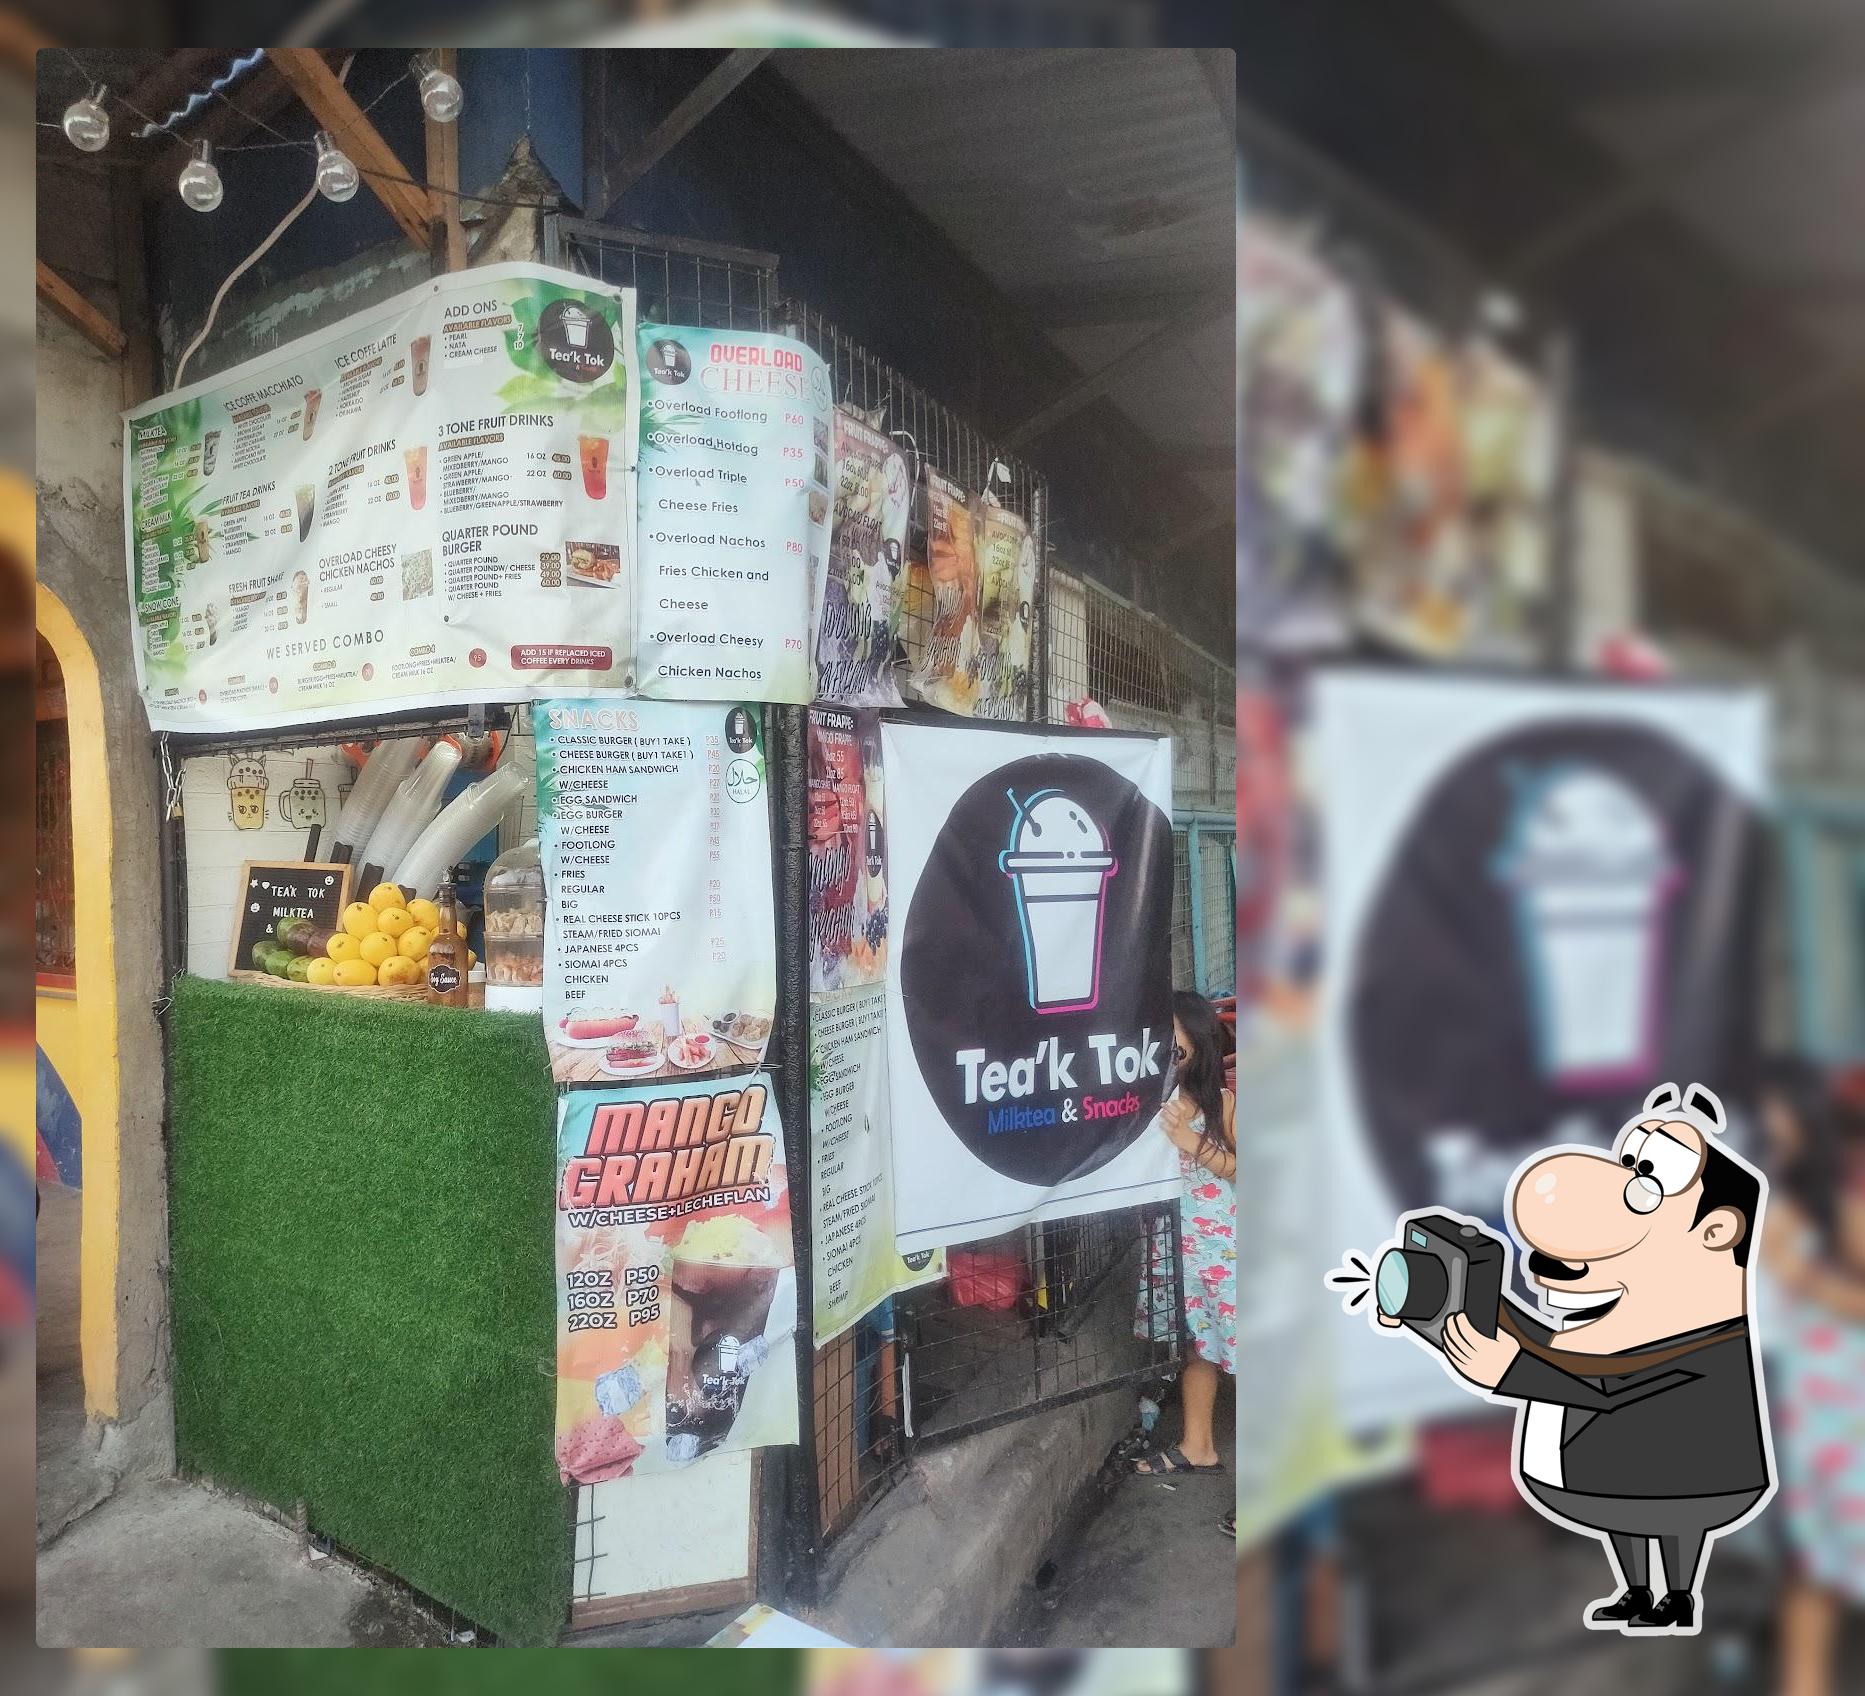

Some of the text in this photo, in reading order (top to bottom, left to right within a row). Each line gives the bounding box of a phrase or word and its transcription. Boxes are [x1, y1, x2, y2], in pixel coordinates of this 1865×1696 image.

[445, 300, 497, 319] ADD ONS
[335, 334, 396, 369] ICE COFFE LATTE
[450, 341, 523, 358] CREAM CHEESE 10
[550, 348, 605, 367] Tea'k Tok
[710, 344, 802, 372] OVERLOAD
[236, 393, 258, 408] COFFE
[256, 375, 303, 400] MACCHIATO
[655, 400, 710, 415] Overload
[715, 408, 767, 423] Footlong
[439, 415, 553, 437] 3 TONE FRUIT DRINKS
[367, 440, 396, 457] DRINKS
[655, 433, 802, 458] Overload Hotdog P35
[655, 466, 714, 479] Overload
[718, 470, 747, 484] Triple
[252, 481, 276, 496] DRINKS
[658, 499, 738, 513] Cheese Fries
[442, 524, 538, 542] QUARTER POUND
[443, 541, 481, 556] BURGER
[656, 532, 802, 553] Overload Nachos P80
[320, 544, 396, 568] OVERLOAD CHEESY
[540, 553, 561, 561] 29.00
[320, 557, 394, 581] CHICKEN NACHOS
[659, 566, 769, 581] Fries Chicken and
[229, 577, 266, 593] FRESH FRUIT
[457, 592, 478, 600] CHEESE
[659, 599, 709, 609] Cheese
[267, 630, 383, 659] WE SERVED COMBO
[656, 632, 802, 649] Overload Cheesy P70
[555, 649, 588, 657] REPLACED
[658, 665, 762, 679] Chicken Nachos
[549, 708, 639, 731] SNACKS
[809, 710, 853, 730] FRUIT FRAPPE:
[558, 736, 684, 745] CLASSIC BURGER TAKE
[559, 751, 593, 759] CHEESE
[596, 751, 630, 760] BURGER
[560, 765, 678, 774] CHICKEN HAM SANDWICH
[728, 767, 758, 787] حلال
[559, 780, 609, 790] W/CHEESE
[560, 794, 637, 805] EGG SANDWICH
[561, 810, 622, 819] EGG BURGER
[561, 826, 609, 835] W/CHEESE
[561, 840, 615, 850] FOOTLONG
[561, 856, 609, 864] W/CHEESE
[562, 871, 585, 879] FRIES
[272, 885, 325, 898] TEA'K TOK
[561, 885, 605, 894] REGULAR
[561, 900, 578, 909] BIG
[273, 907, 314, 919] MILKTEA
[564, 912, 681, 924] REAL CHEESE STICK 10PCS
[266, 924, 273, 933] &
[563, 928, 660, 939] STEAM/FRIED SIOMAI
[565, 944, 638, 954] JAPANESE 4PCS
[565, 959, 627, 969] SIOMAI 4PCS
[440, 974, 457, 985] Sauce
[565, 975, 609, 984] CHICKEN
[565, 991, 586, 999] BEEF
[956, 1028, 1161, 1104] Tea'k Tok
[836, 1082, 854, 1096] BURGER
[584, 1084, 767, 1156] MANGO
[988, 1091, 1139, 1135] Milktea & Snacks
[826, 1114, 852, 1131] FOOTLONG
[560, 1133, 776, 1210] GRAHAM
[821, 1162, 844, 1180] REGULAR
[836, 1189, 858, 1205] CHEESE
[568, 1187, 771, 1229] W/CHEESE+LECHEFLAN
[825, 1222, 854, 1245] JAPANESE
[826, 1243, 848, 1261] SIOMAI
[828, 1257, 853, 1277] CHICKEN
[567, 1265, 659, 1288] 12OZ P50
[829, 1280, 841, 1294] BEEF
[568, 1287, 659, 1309] 16OZ P70
[828, 1291, 848, 1309] SHRIMP
[568, 1306, 659, 1331] 22OZ P95
